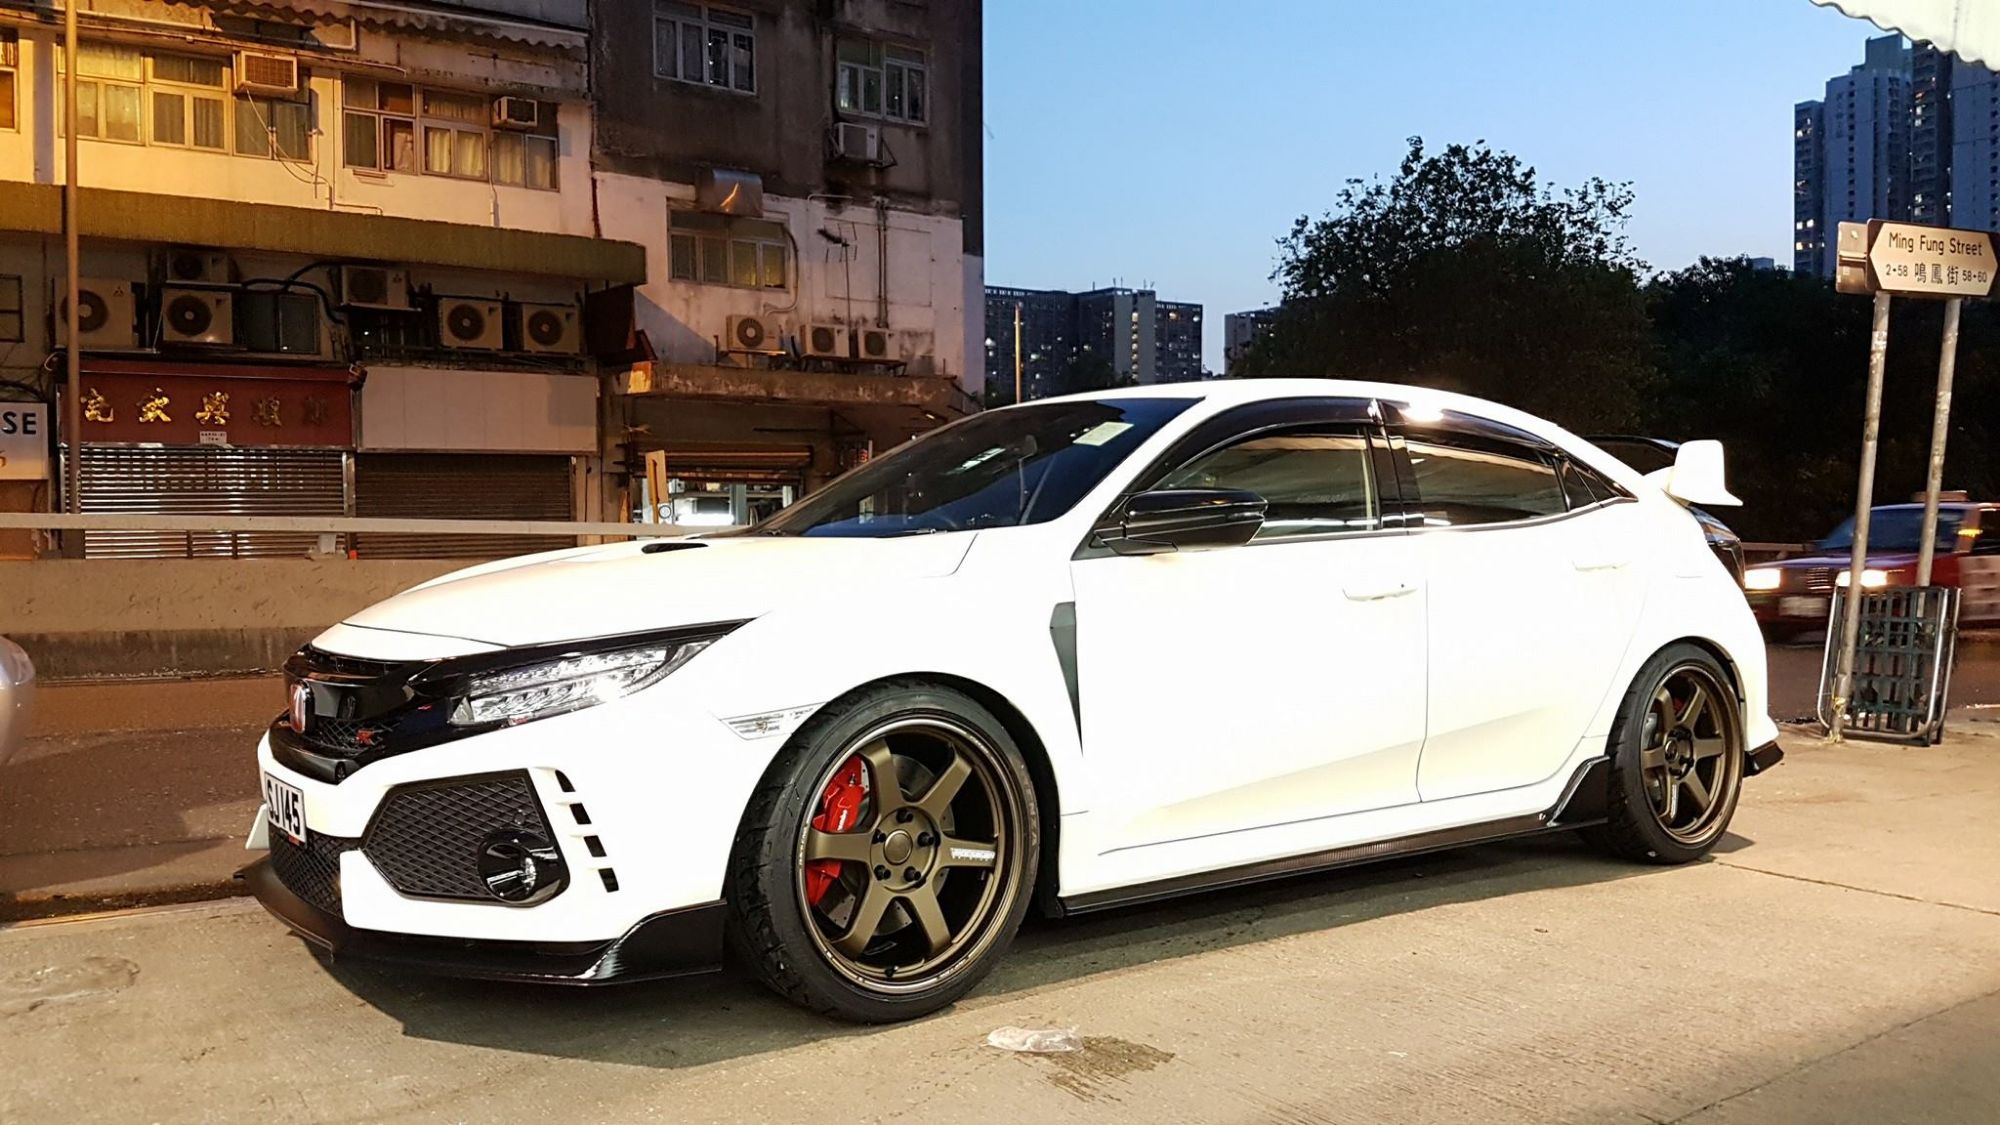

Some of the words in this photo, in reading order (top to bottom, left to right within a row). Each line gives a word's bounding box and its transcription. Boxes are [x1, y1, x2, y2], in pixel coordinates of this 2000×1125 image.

[1888, 231, 1914, 253] Ming
[1920, 234, 1945, 256] Fung
[1949, 237, 1982, 256] Street
[1914, 262, 1959, 285] 鳴鳳街
